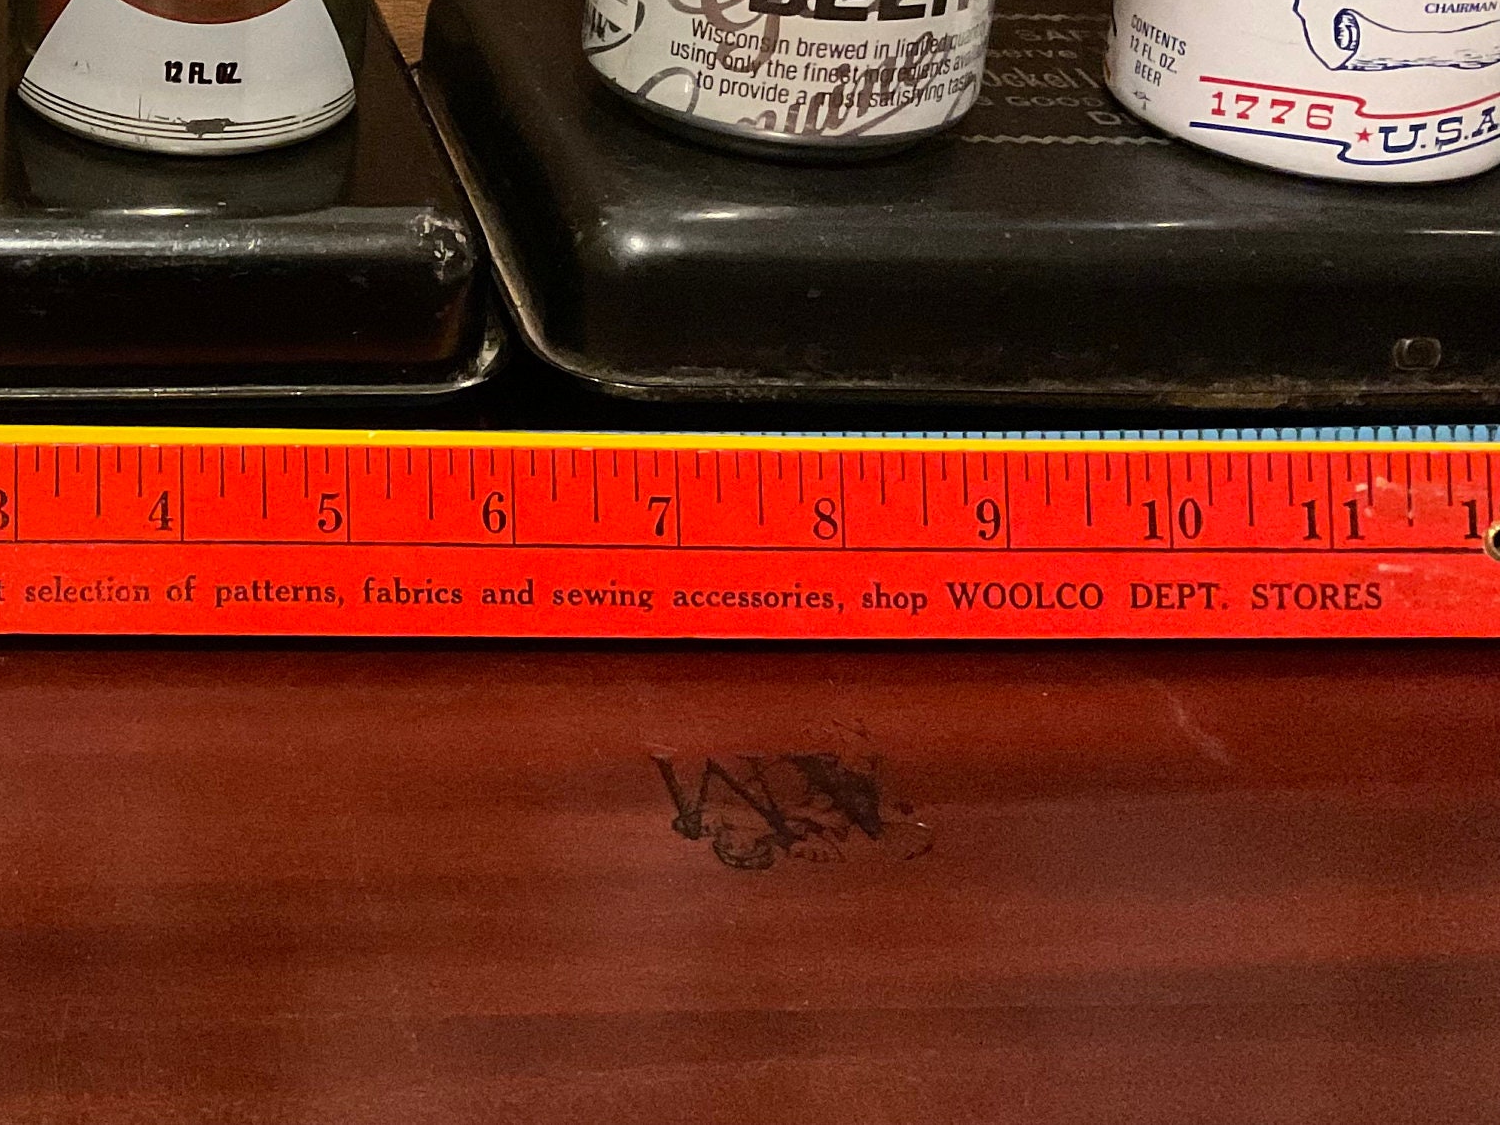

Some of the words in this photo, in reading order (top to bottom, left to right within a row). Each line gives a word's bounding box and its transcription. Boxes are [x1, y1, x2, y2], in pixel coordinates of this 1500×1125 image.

[1424, 1, 1497, 14] CHAIRMAN
[692, 18, 790, 55] Wisconsn
[796, 37, 868, 60] brewed
[874, 39, 889, 60] in
[1129, 34, 1139, 53] 12
[1130, 14, 1187, 56] CONTENTS
[164, 60, 183, 83] 12
[670, 40, 717, 71] using
[766, 59, 798, 81] the
[1134, 59, 1162, 87] BEER
[696, 70, 714, 90] to
[719, 80, 790, 104] provide
[795, 90, 808, 105] a
[1211, 91, 1335, 131] 1776
[148, 490, 175, 532] 4
[317, 493, 344, 534] 5
[481, 492, 508, 534] 6
[647, 496, 672, 538] 7
[812, 498, 839, 541] 8
[975, 498, 1002, 541] 9
[1143, 498, 1202, 541] 10
[1301, 499, 1363, 541] 11
[25, 577, 151, 604] selection
[166, 575, 197, 603] of
[214, 579, 346, 608] patterns,
[363, 577, 463, 605] fabrics
[481, 579, 535, 606] and
[552, 583, 654, 610] sewing
[672, 581, 845, 612] accessories,
[861, 583, 928, 614] shop
[946, 582, 1103, 611] WOOLCO
[1129, 582, 1228, 611] DEPT.
[1250, 582, 1382, 611] STORES
